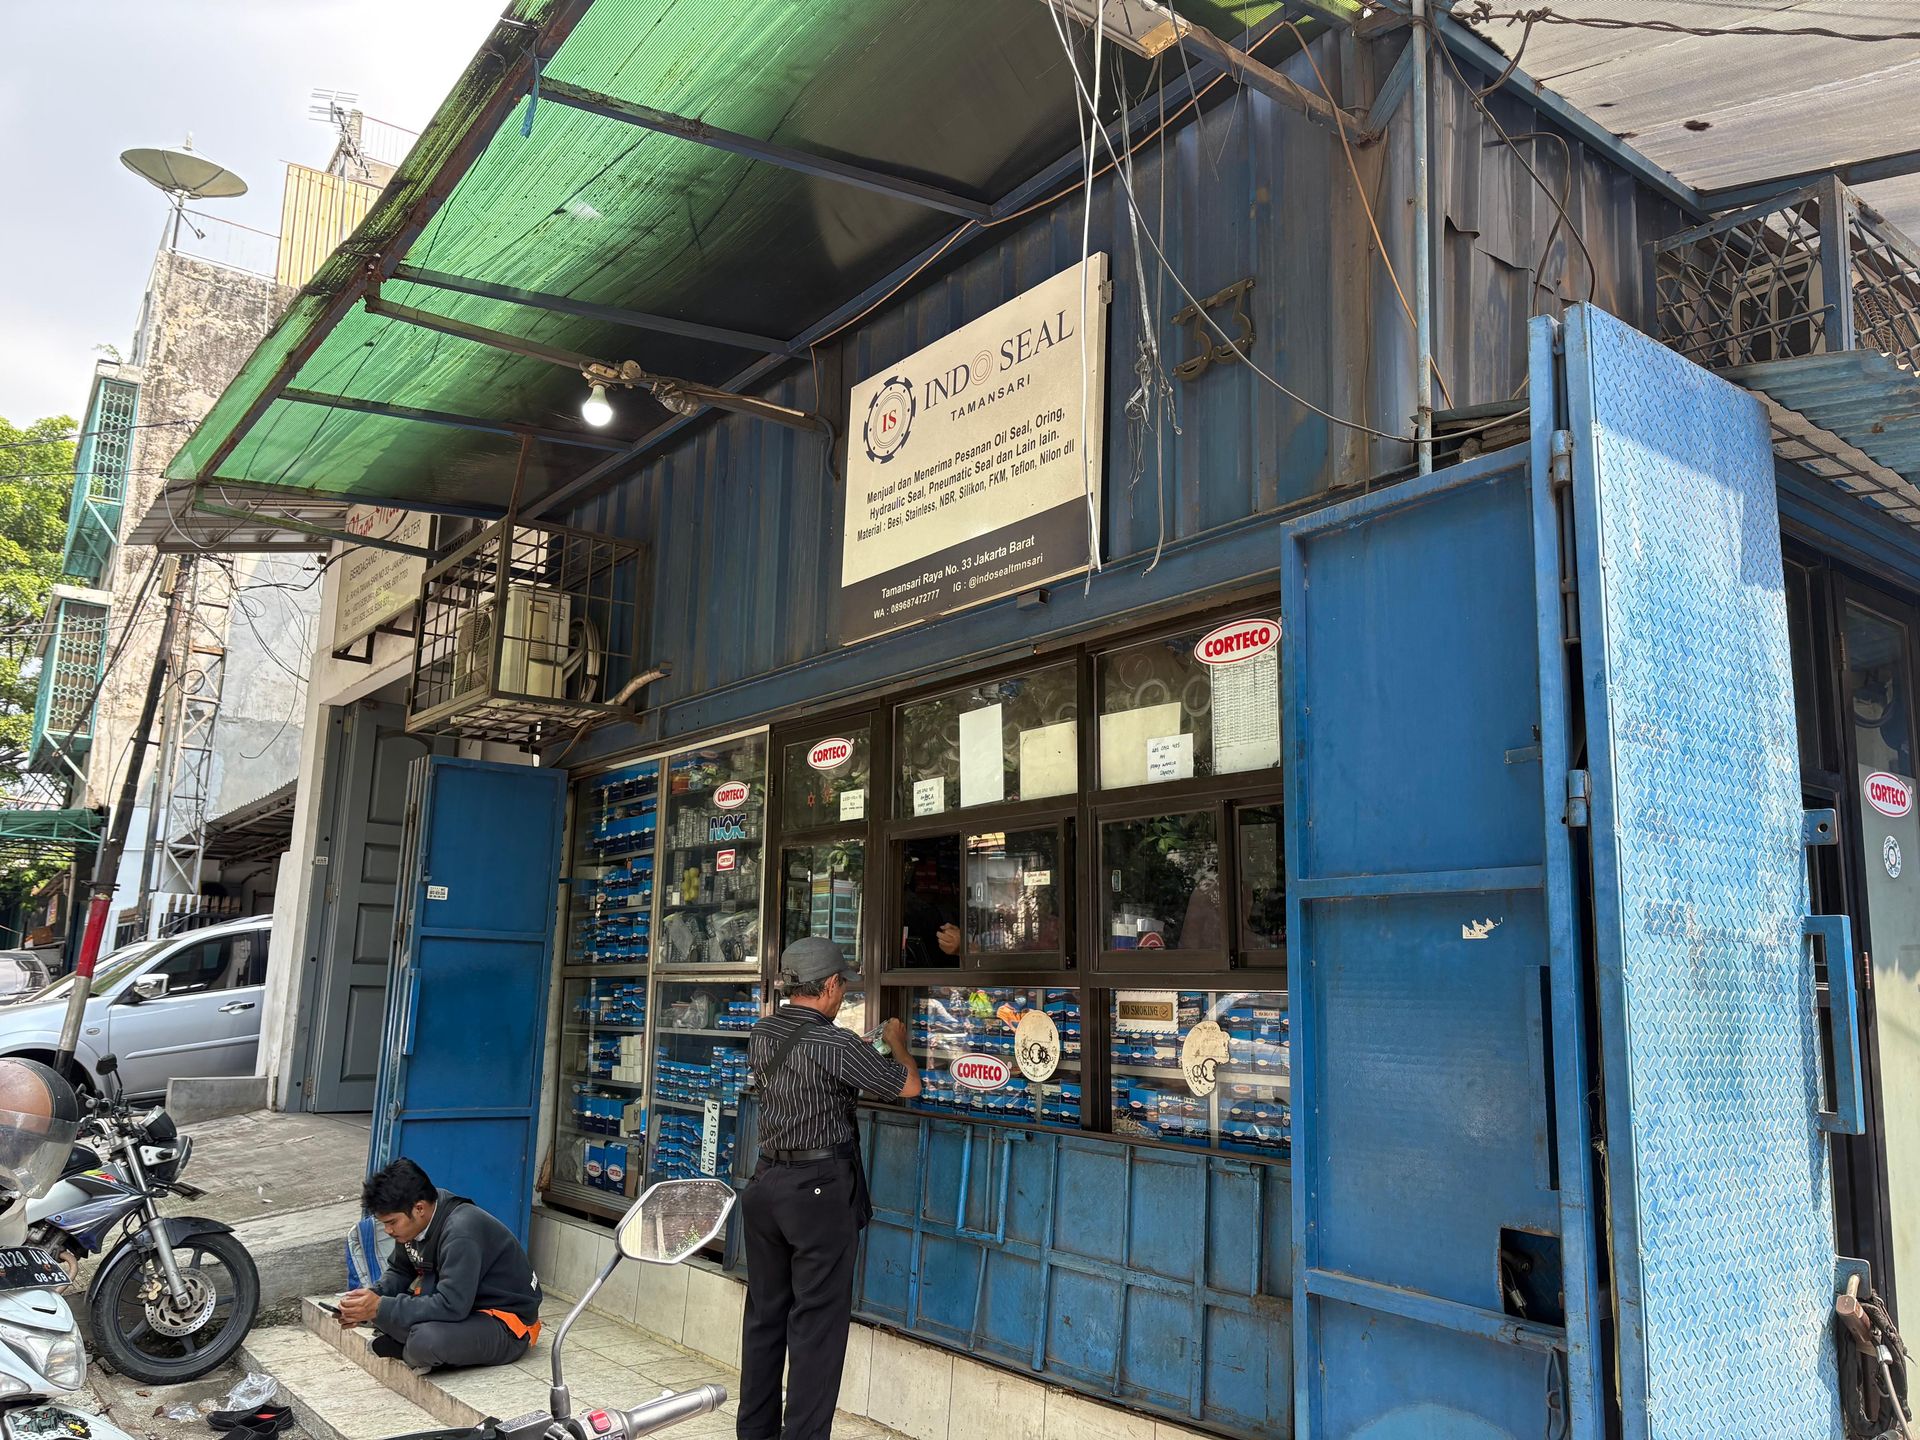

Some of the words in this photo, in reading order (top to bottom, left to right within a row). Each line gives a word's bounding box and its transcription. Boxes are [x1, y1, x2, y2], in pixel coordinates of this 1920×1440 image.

[923, 349, 993, 411] INDO
[1000, 309, 1075, 372] SEAL
[950, 374, 1030, 421] TAMANSARI
[882, 408, 897, 433] IS
[866, 481, 896, 504] Menjual
[897, 476, 912, 491] dan
[914, 458, 952, 484] Menerima
[954, 440, 991, 465] Pesanan
[994, 430, 1007, 447] Oil
[1009, 420, 1032, 441] Seal,
[1035, 408, 1065, 428] Oring,
[857, 521, 882, 541] Material
[887, 512, 904, 529] Besi,
[905, 501, 938, 522] Stainless,
[939, 490, 957, 507] NBR,
[959, 480, 987, 500] Silikon,
[988, 468, 1008, 487] FKM,
[1010, 459, 1037, 478] Teflon,
[1039, 447, 1061, 465] Nilon
[1063, 438, 1075, 455] dll
[869, 497, 905, 521] Hydraulic
[907, 485, 926, 503] Seal,
[929, 467, 972, 494] Pneumatic
[974, 455, 994, 474] Seal
[996, 449, 1013, 465] dan
[1016, 438, 1036, 456] Lain
[1039, 429, 1060, 446] lain.
[881, 575, 921, 599] Tamansari
[922, 570, 943, 585] Raya
[945, 564, 959, 577] No.
[961, 557, 972, 570] 33
[973, 546, 1007, 566] Jakarta
[1009, 534, 1035, 554] Barat
[952, 581, 961, 592] IG
[968, 552, 1043, 588] @indosealtmnsari
[873, 608, 885, 619] WA
[1204, 627, 1271, 658] CORTECO
[812, 744, 847, 764] CORTECO
[717, 788, 745, 803] CORTECO
[1870, 782, 1907, 808] CORTECO
[709, 813, 747, 842] NOK
[1121, 1004, 1130, 1016] NO
[1131, 1004, 1159, 1017] SMOKING
[957, 1062, 1002, 1082] CORTECO
[707, 1151, 715, 1173] UDX
